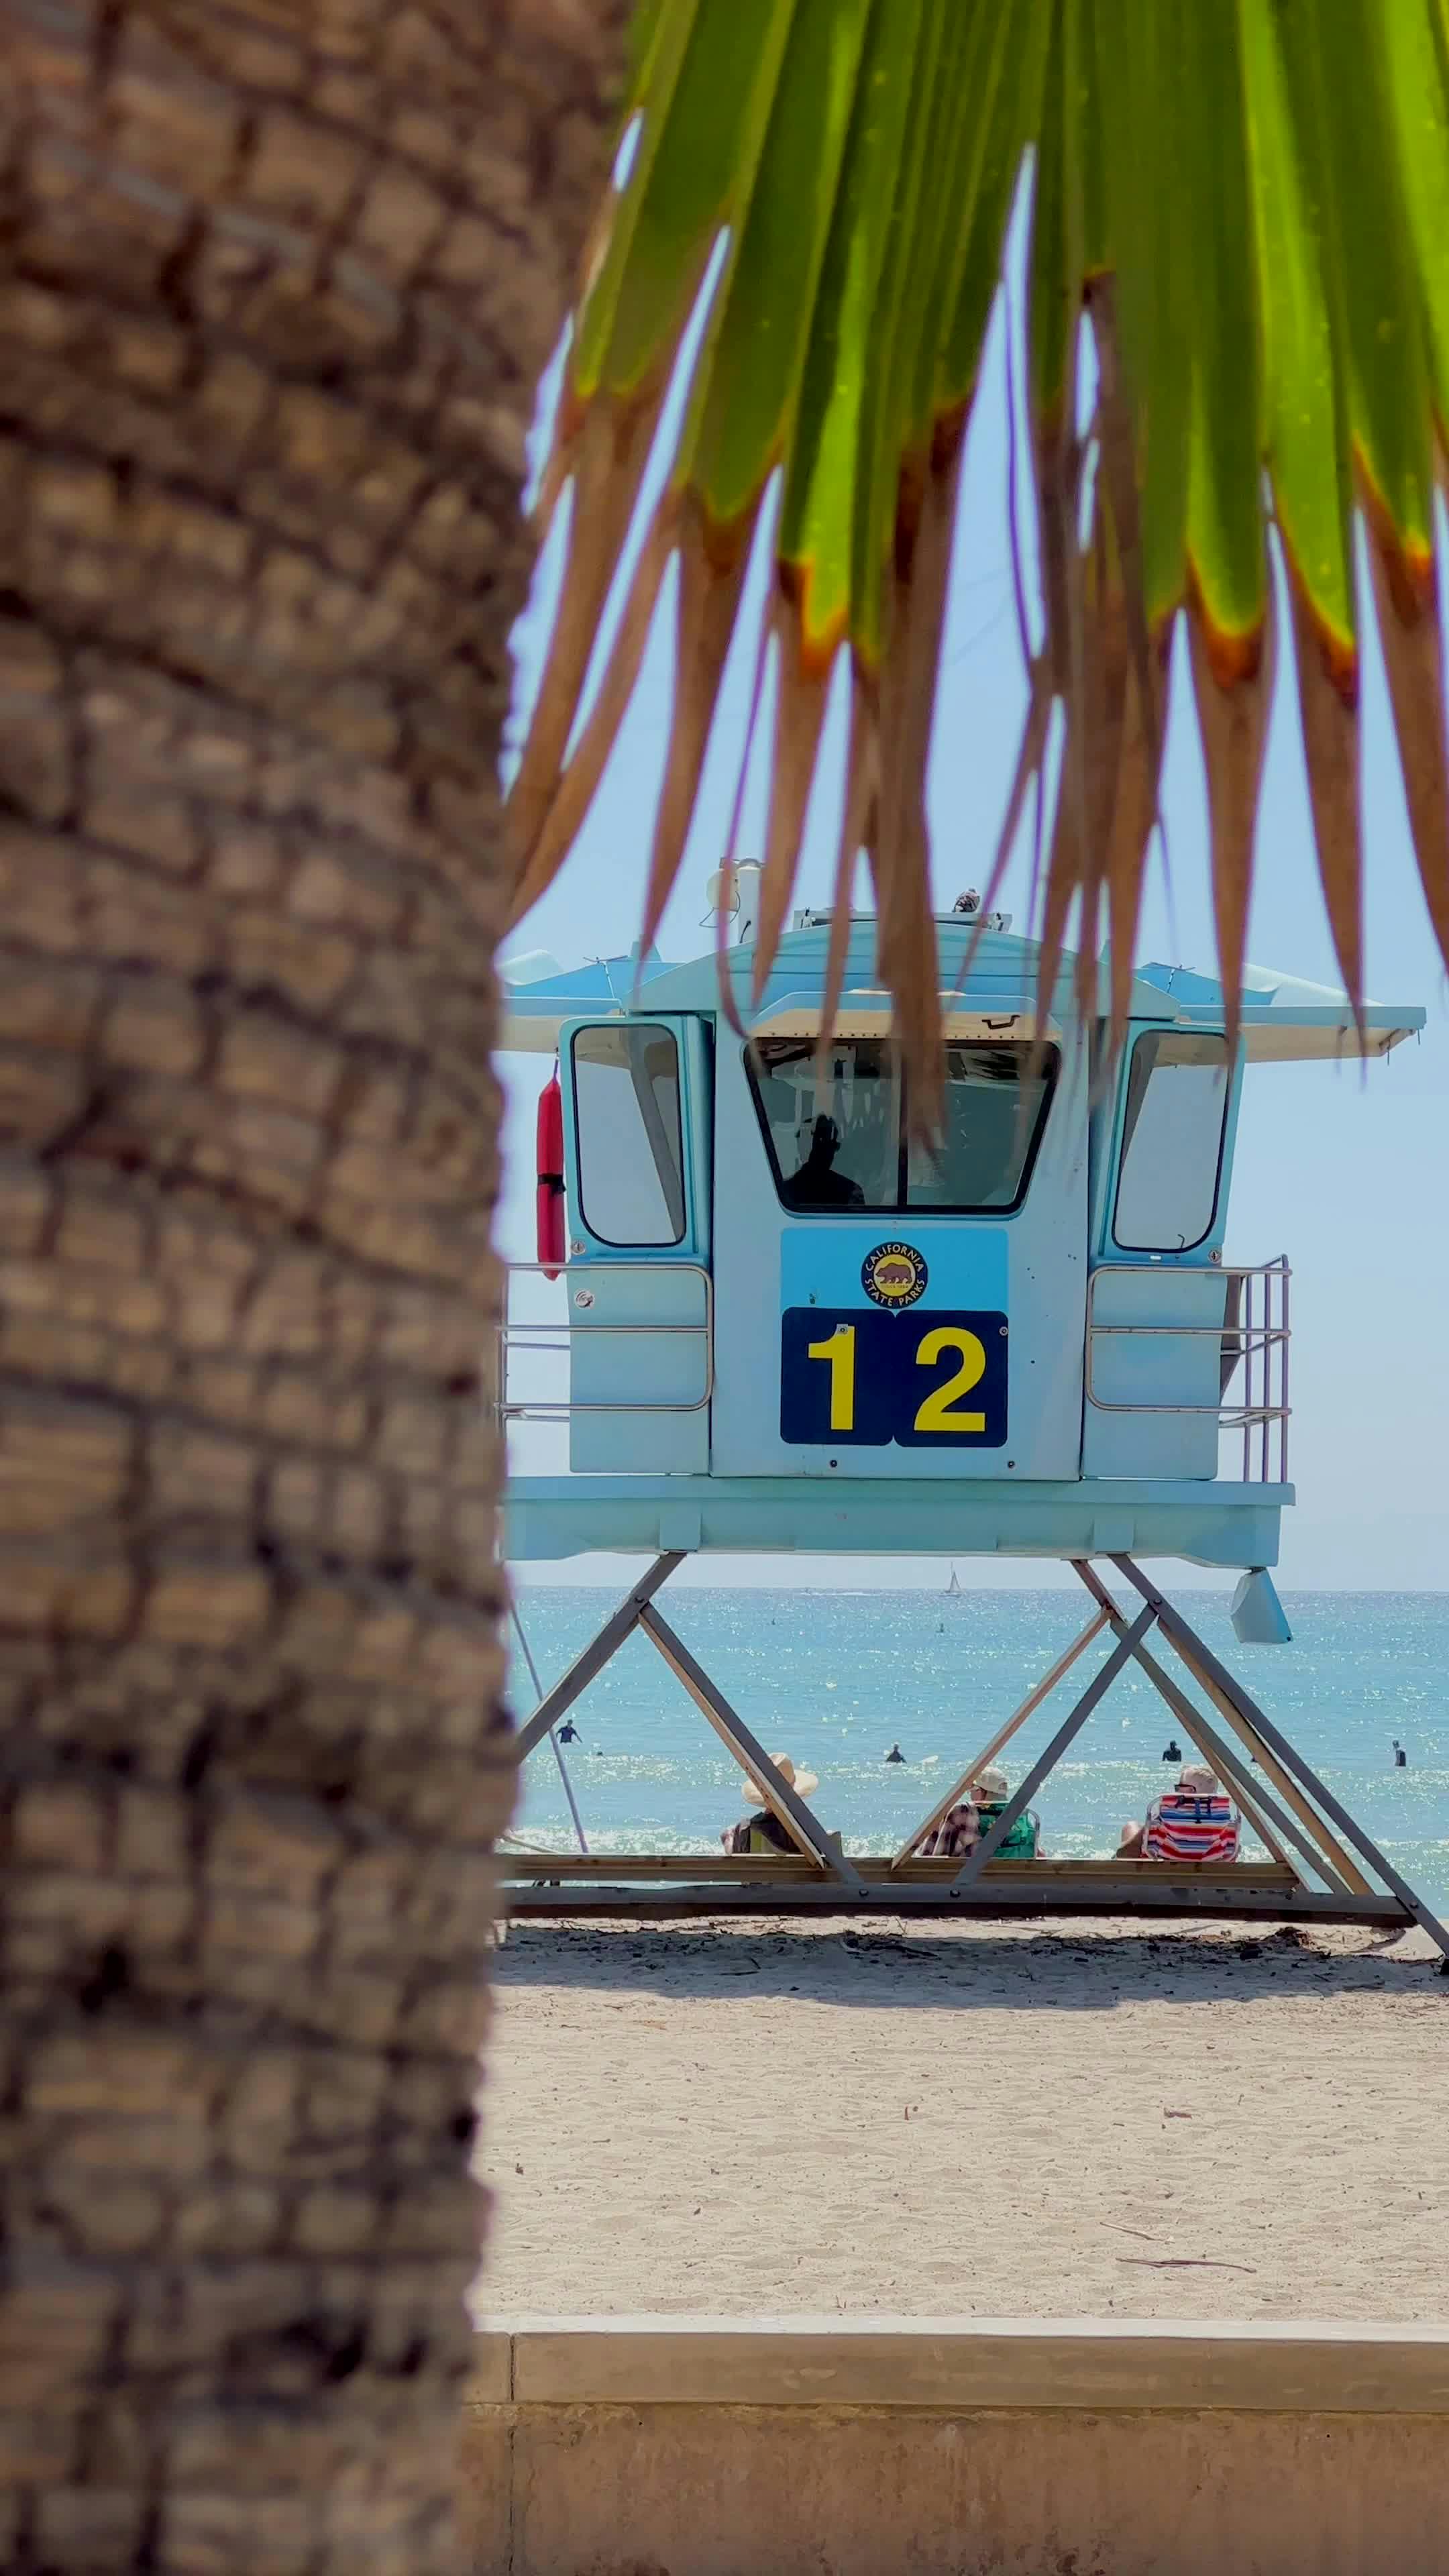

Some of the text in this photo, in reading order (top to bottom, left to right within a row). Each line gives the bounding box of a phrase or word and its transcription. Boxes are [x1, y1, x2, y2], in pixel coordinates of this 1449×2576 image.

[865, 1244, 924, 1271] CALIFORNIA
[865, 1279, 924, 1306] STATE PARKS
